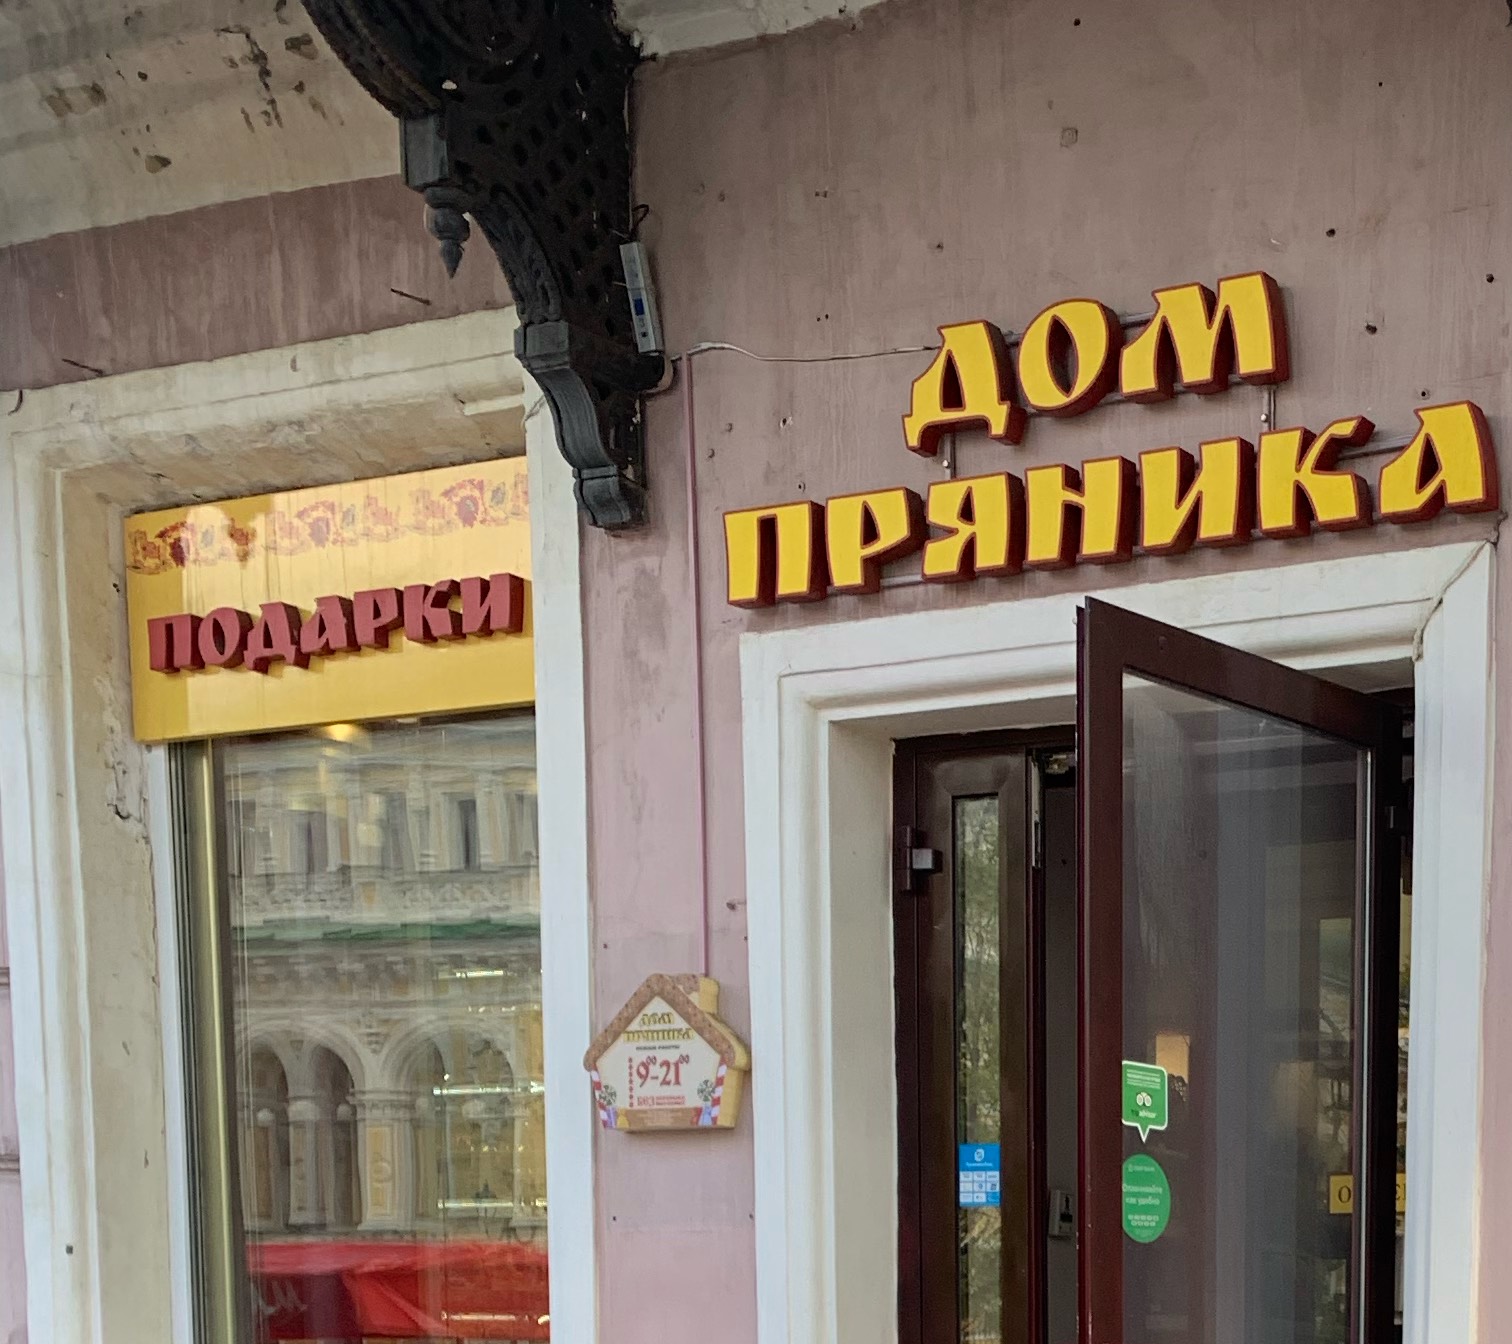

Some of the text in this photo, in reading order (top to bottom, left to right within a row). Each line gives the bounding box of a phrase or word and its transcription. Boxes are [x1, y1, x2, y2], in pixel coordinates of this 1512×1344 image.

[902, 270, 1290, 456] ДОМ
[723, 400, 1501, 609] ПРЯНИКА
[147, 572, 528, 674] ПОДАРКИ
